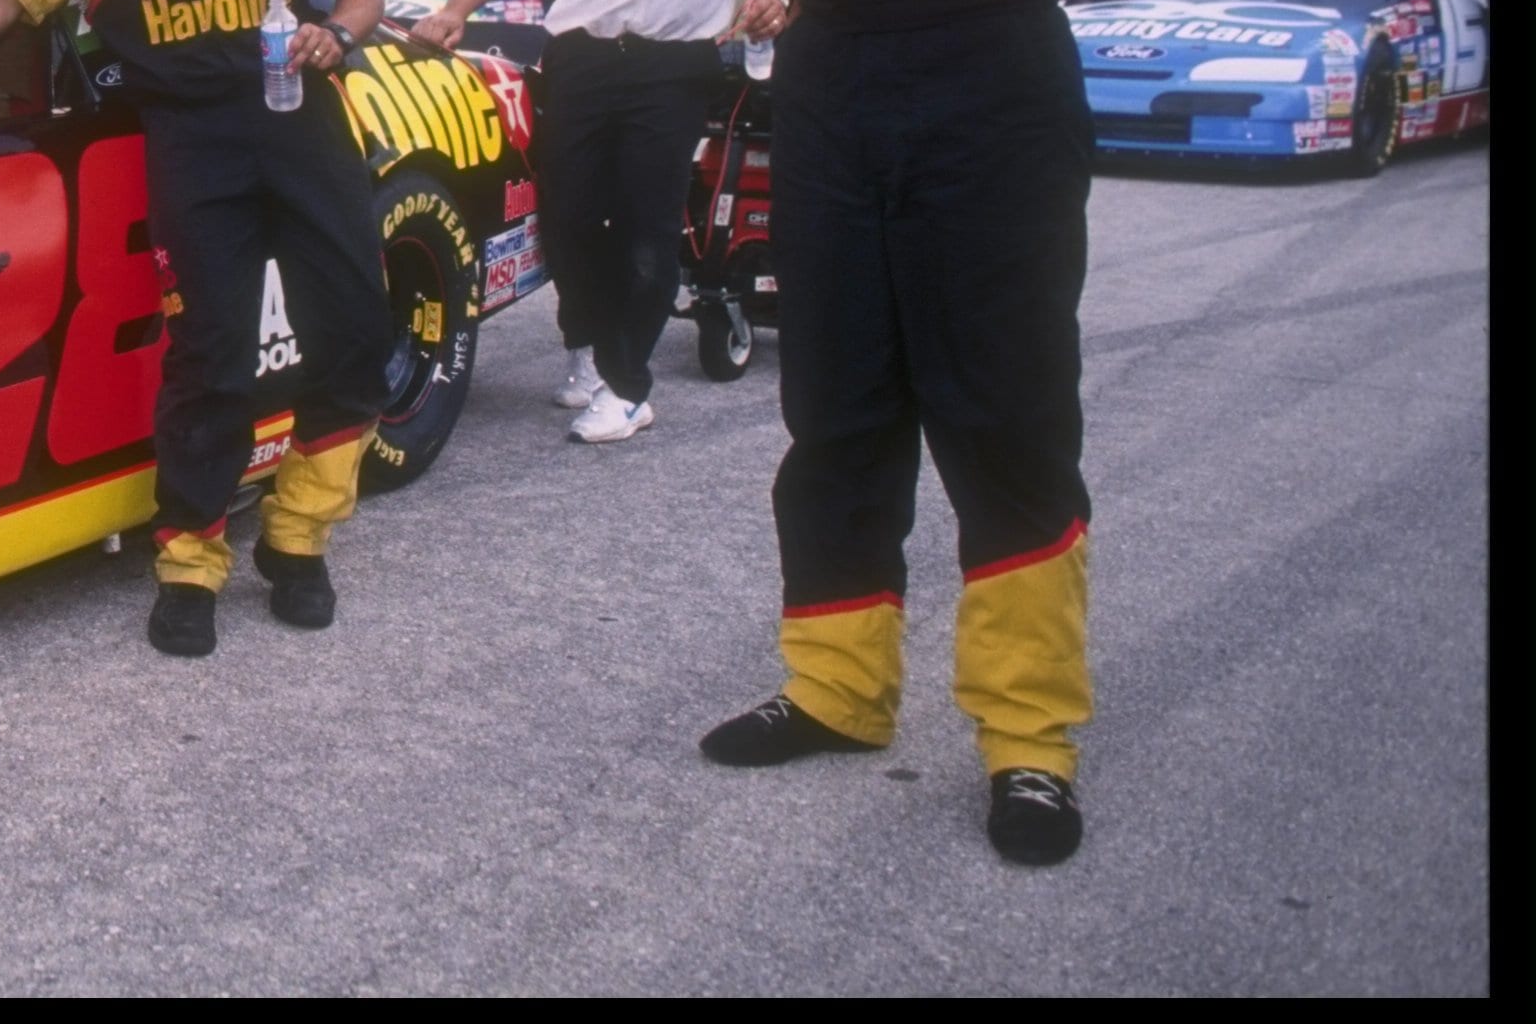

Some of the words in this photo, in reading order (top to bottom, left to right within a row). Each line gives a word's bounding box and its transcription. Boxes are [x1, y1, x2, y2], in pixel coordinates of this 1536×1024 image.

[1175, 21, 1293, 47] Care
[487, 257, 517, 293] MSD
[374, 433, 405, 467] EAGL
